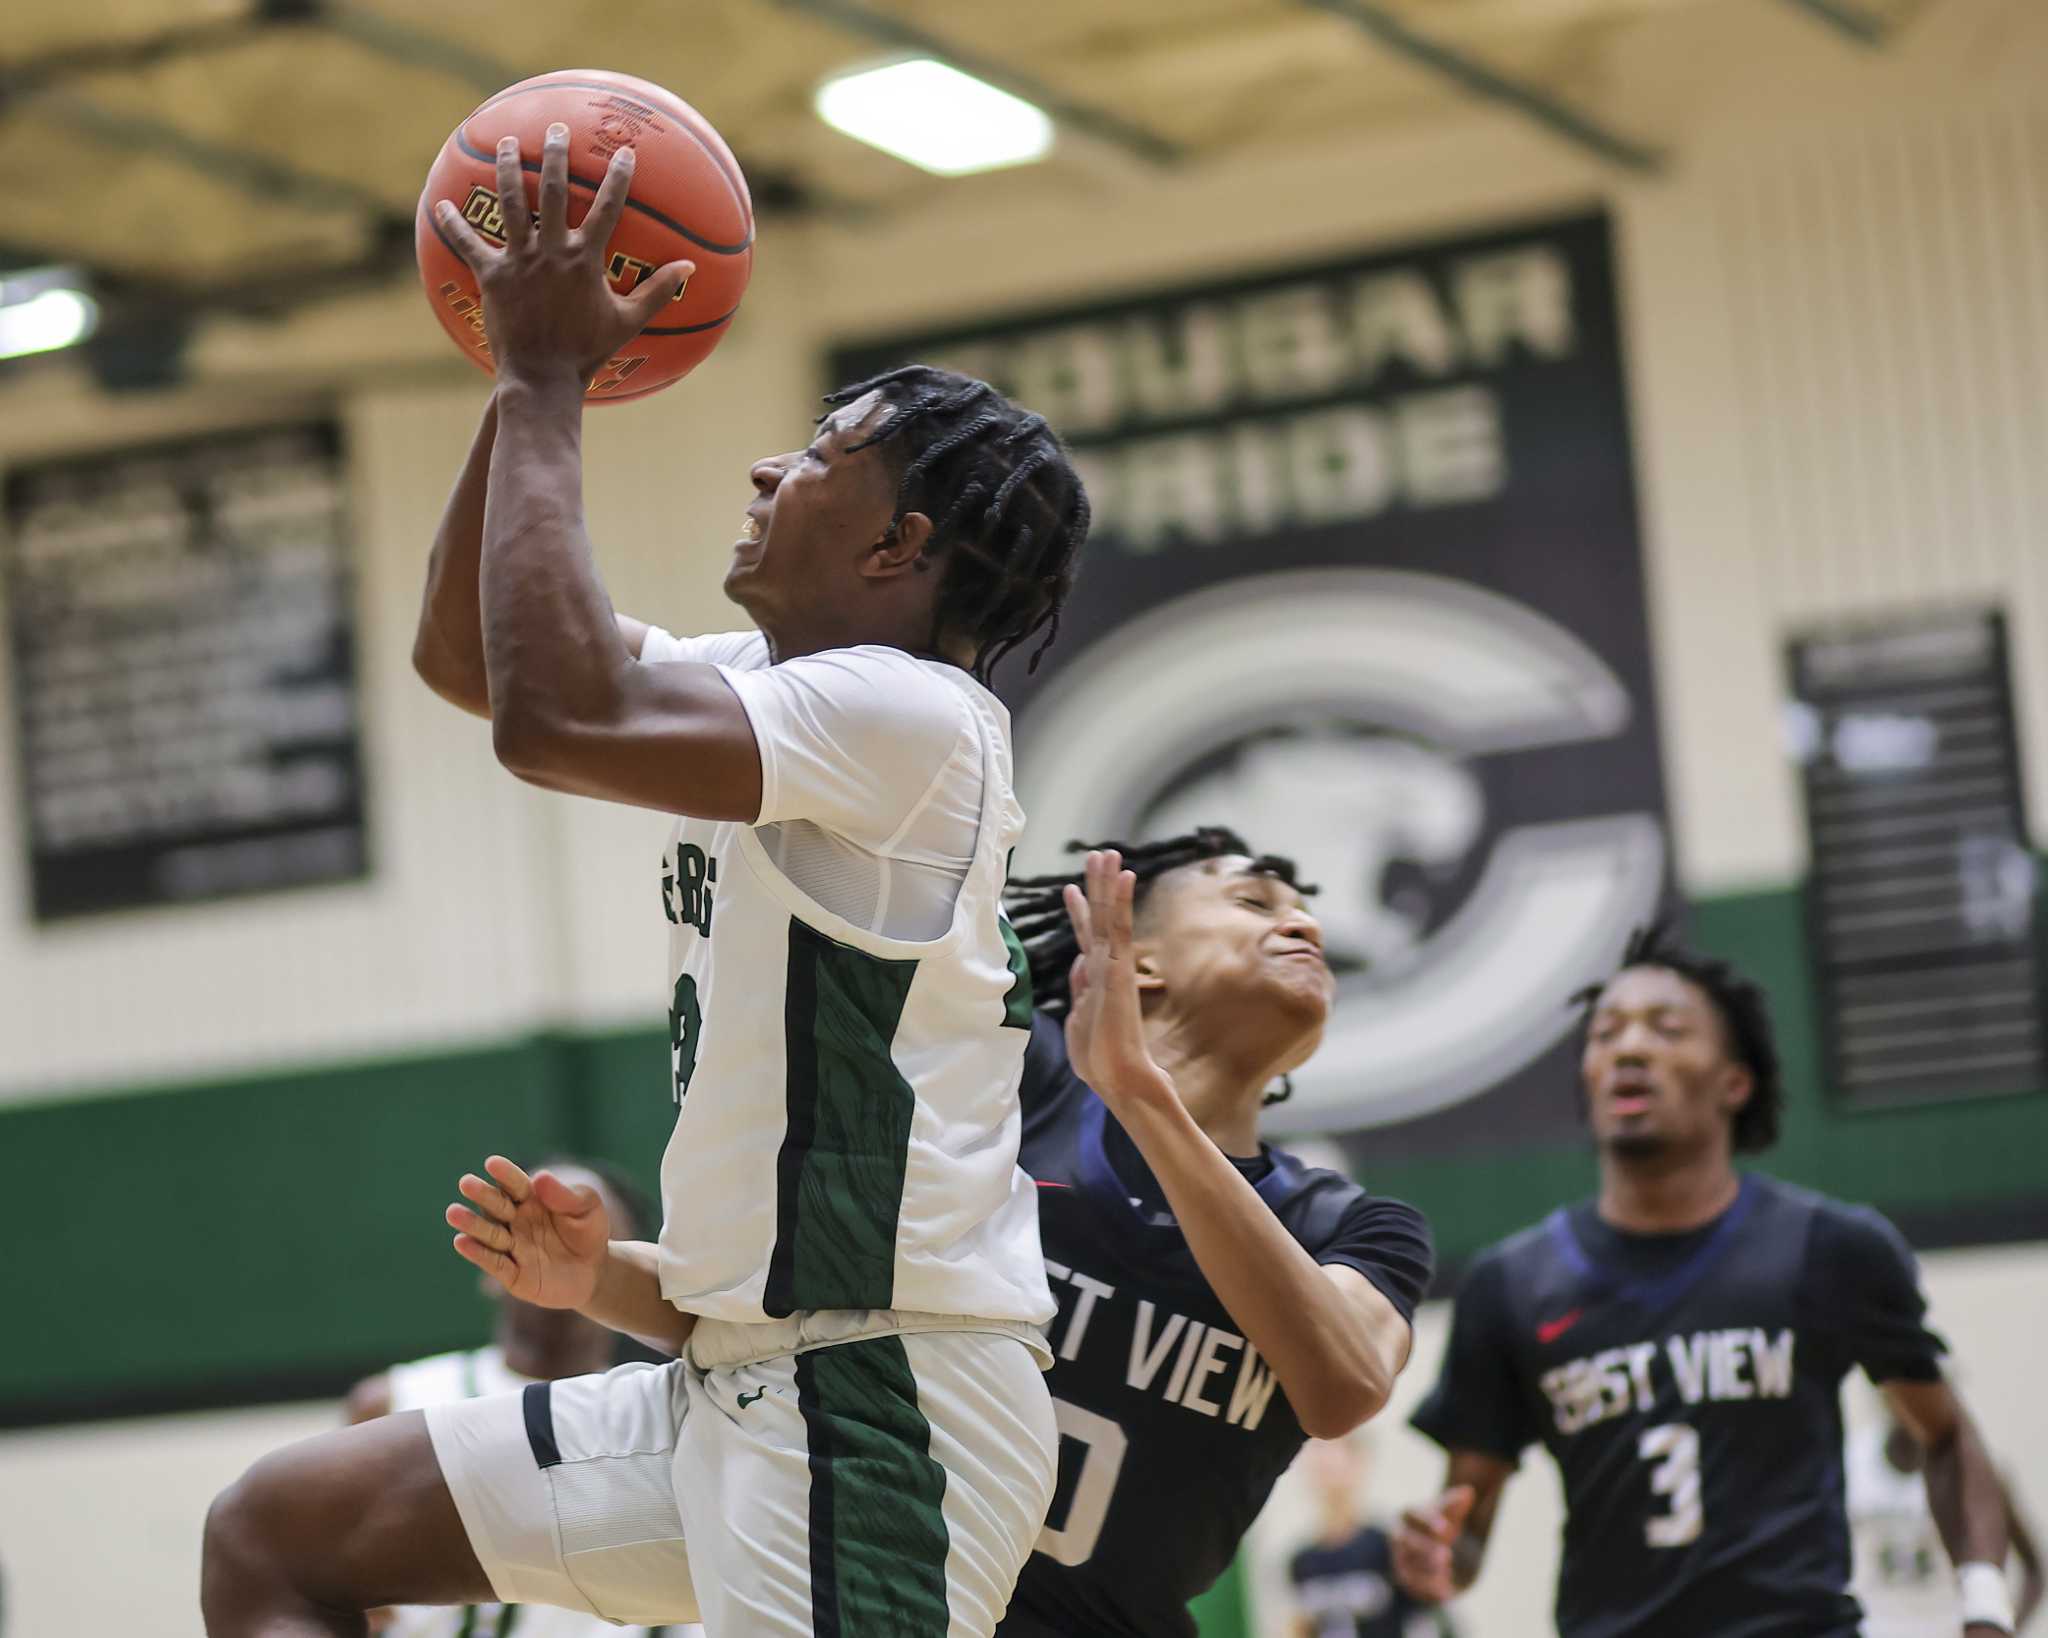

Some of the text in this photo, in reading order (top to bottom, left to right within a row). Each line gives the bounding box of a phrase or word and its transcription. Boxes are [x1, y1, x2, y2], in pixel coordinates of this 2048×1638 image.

[1126, 1299, 1279, 1431] VIEW
[1667, 1326, 1795, 1405] VIEW
[1637, 1422, 1704, 1547] 3
